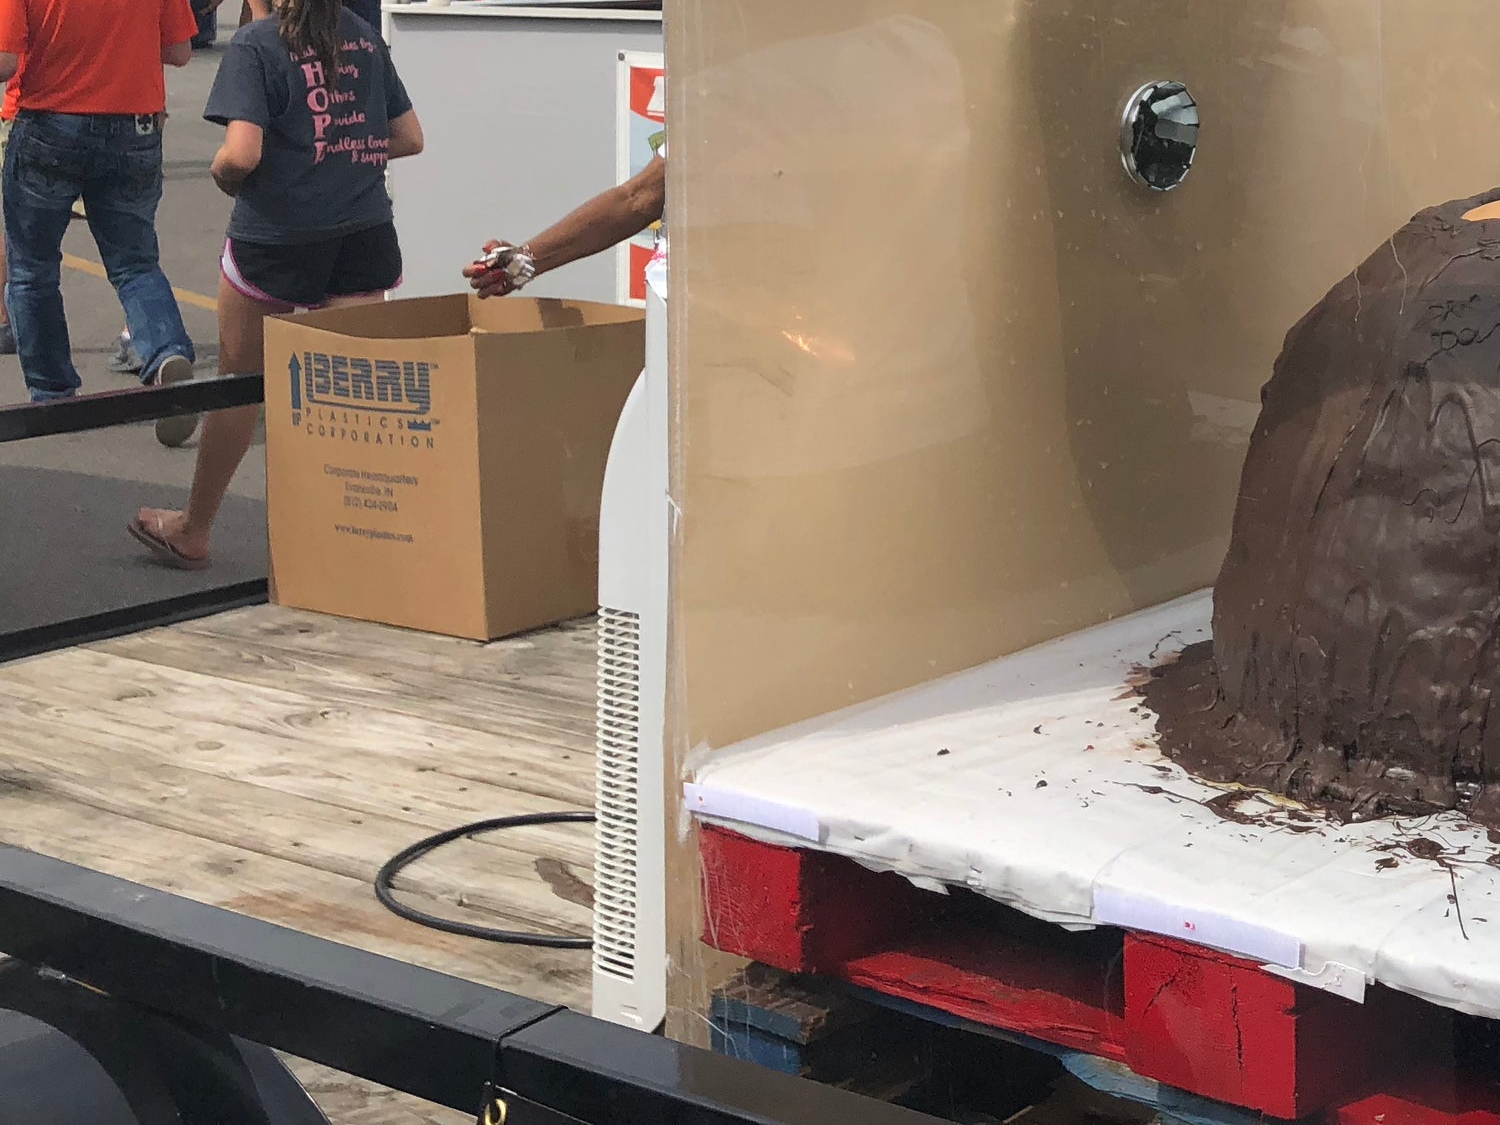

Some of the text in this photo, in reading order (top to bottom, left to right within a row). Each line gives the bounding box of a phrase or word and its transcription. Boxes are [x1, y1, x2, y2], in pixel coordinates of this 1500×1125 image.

[304, 351, 431, 416] BERRY
[306, 407, 404, 430] PLASTICS
[307, 423, 434, 449] CORPORATION
